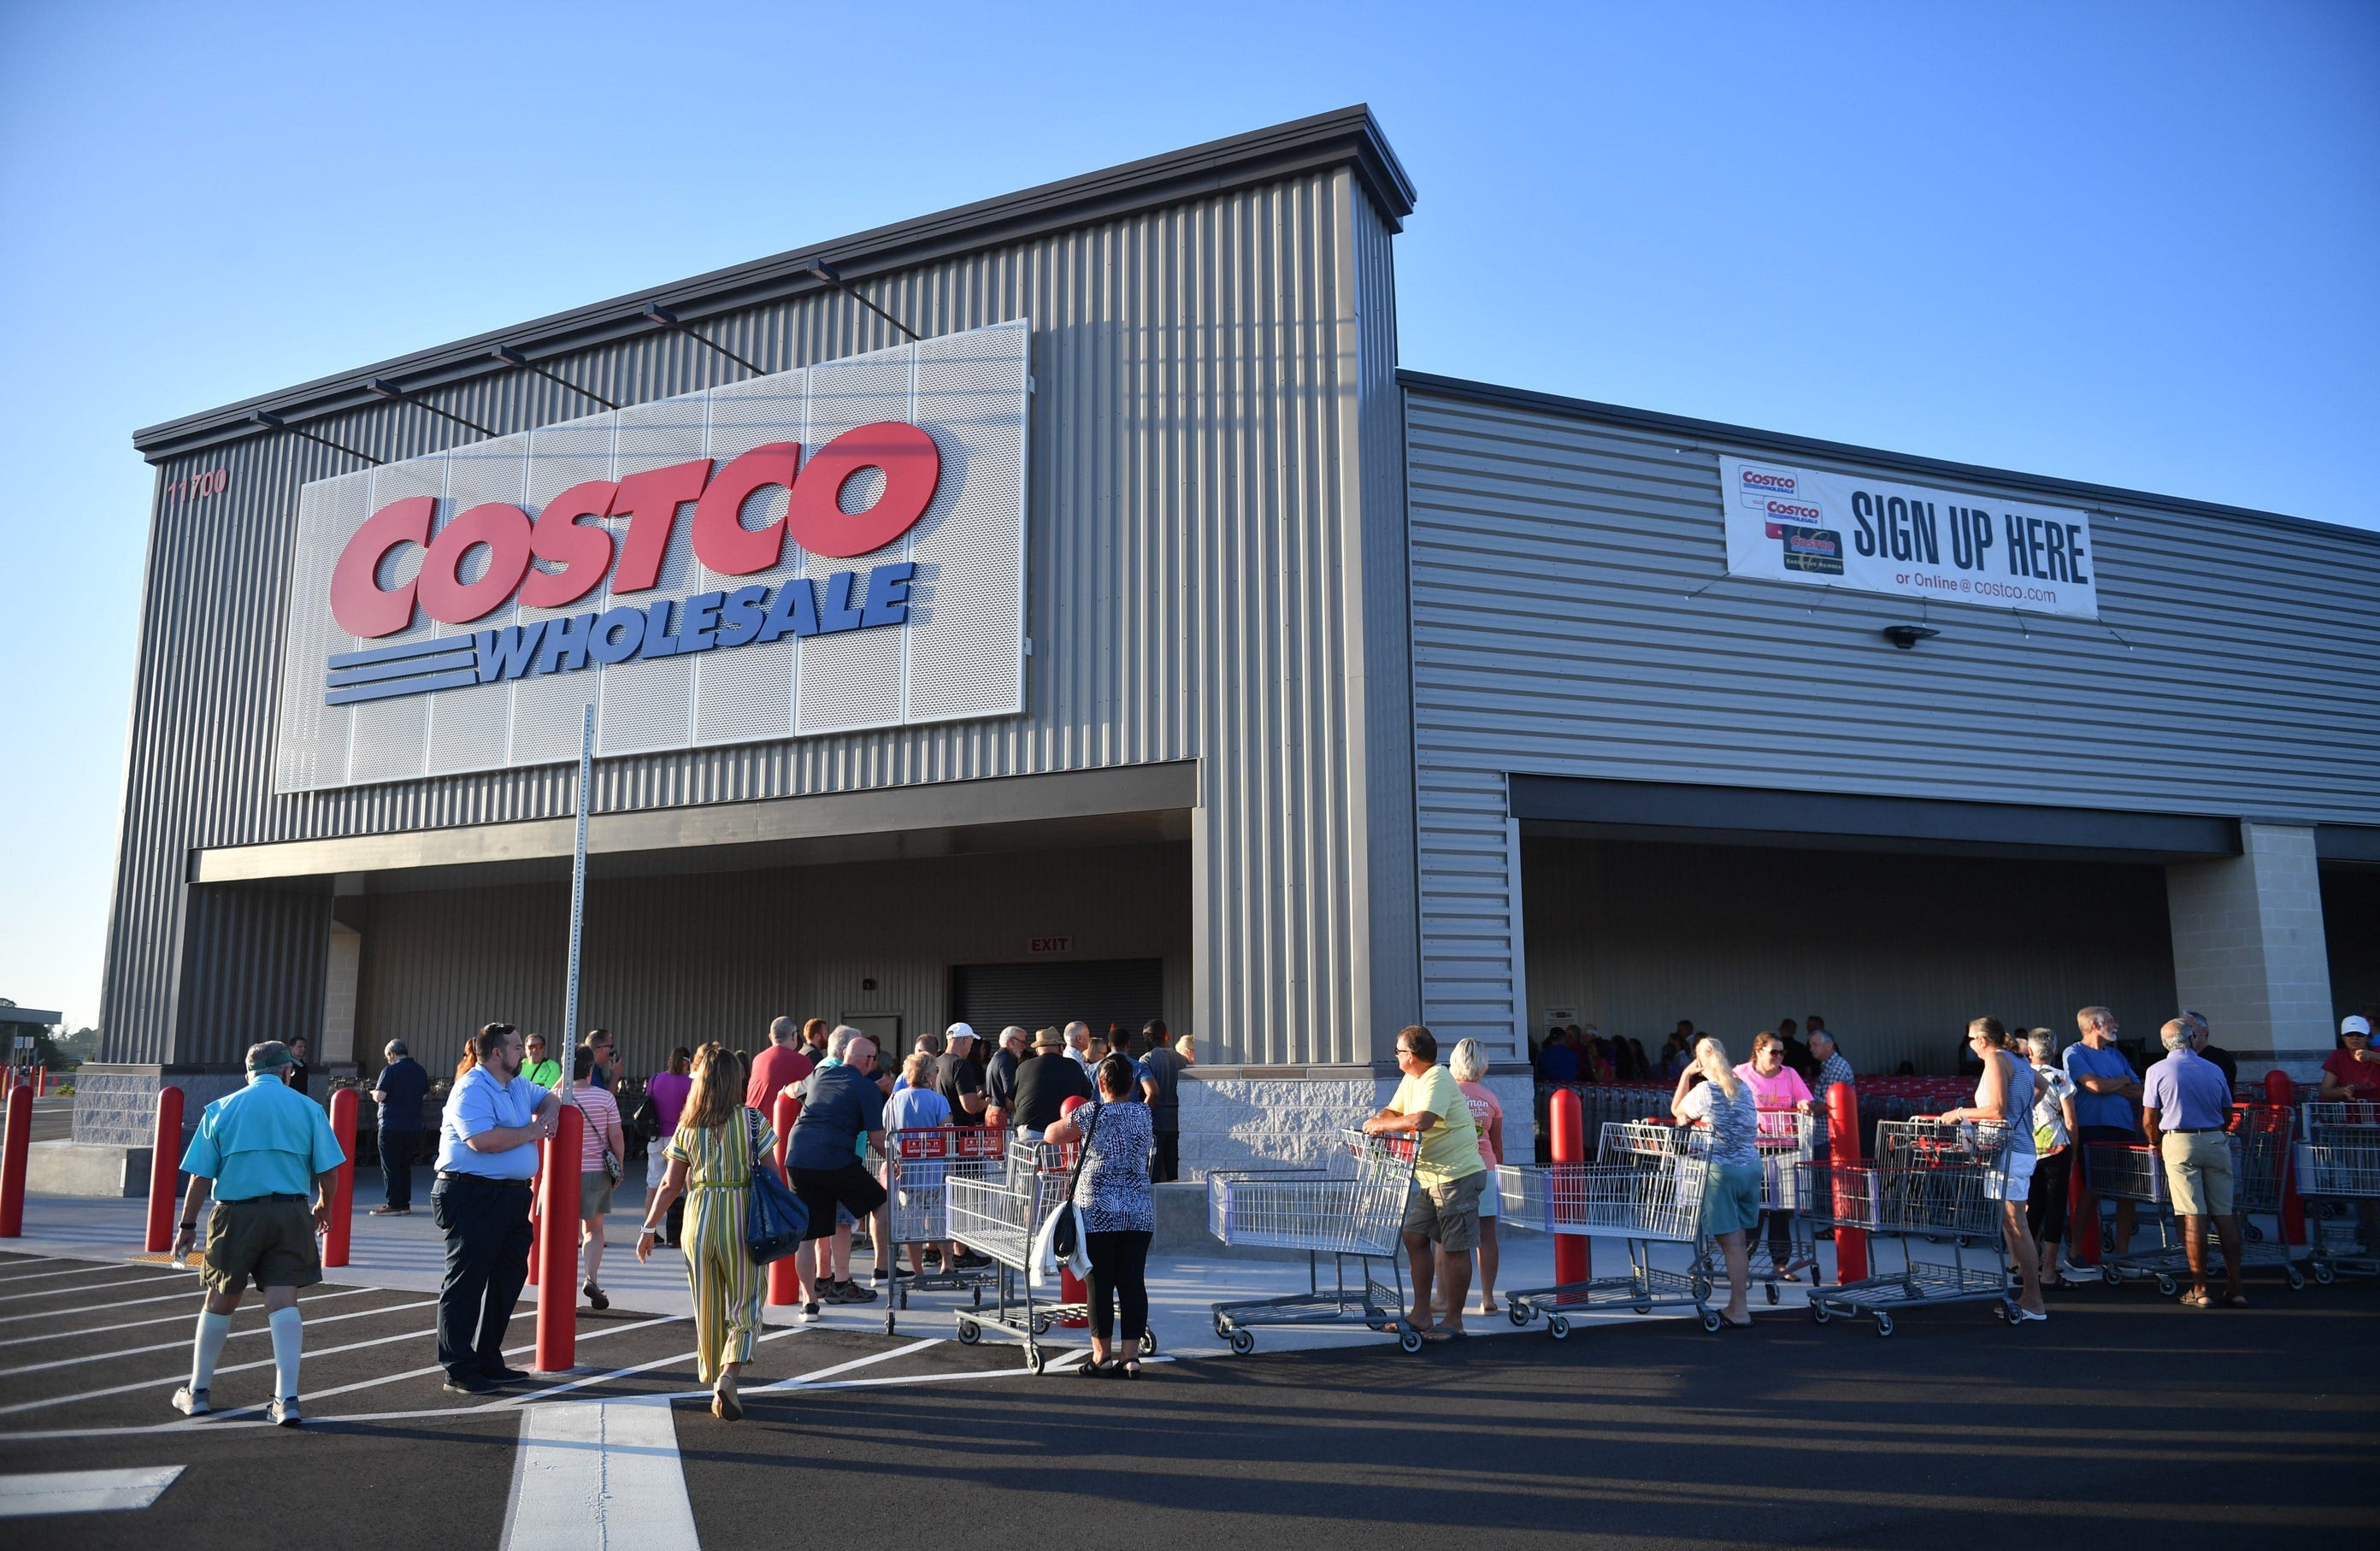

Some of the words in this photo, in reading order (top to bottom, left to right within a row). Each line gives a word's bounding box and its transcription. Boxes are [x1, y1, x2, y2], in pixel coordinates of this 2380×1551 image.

[168, 468, 227, 504] 11700
[1742, 471, 1795, 488] COSTCO
[1761, 486, 1794, 494] WHOLESALE
[1767, 501, 1819, 518] COSTCO
[331, 421, 941, 638] COSTCO
[1852, 491, 1940, 564] SIGN
[1949, 505, 1993, 570] UP
[2005, 514, 2088, 584] HERE
[1790, 535, 1835, 550] COSTCO
[1896, 573, 1910, 585] or
[1914, 573, 1958, 591] Online
[1960, 579, 1971, 593] @
[1975, 581, 2056, 604] costco.com
[474, 562, 916, 682] WHOLESALE
[1032, 937, 1068, 952] EXIT
